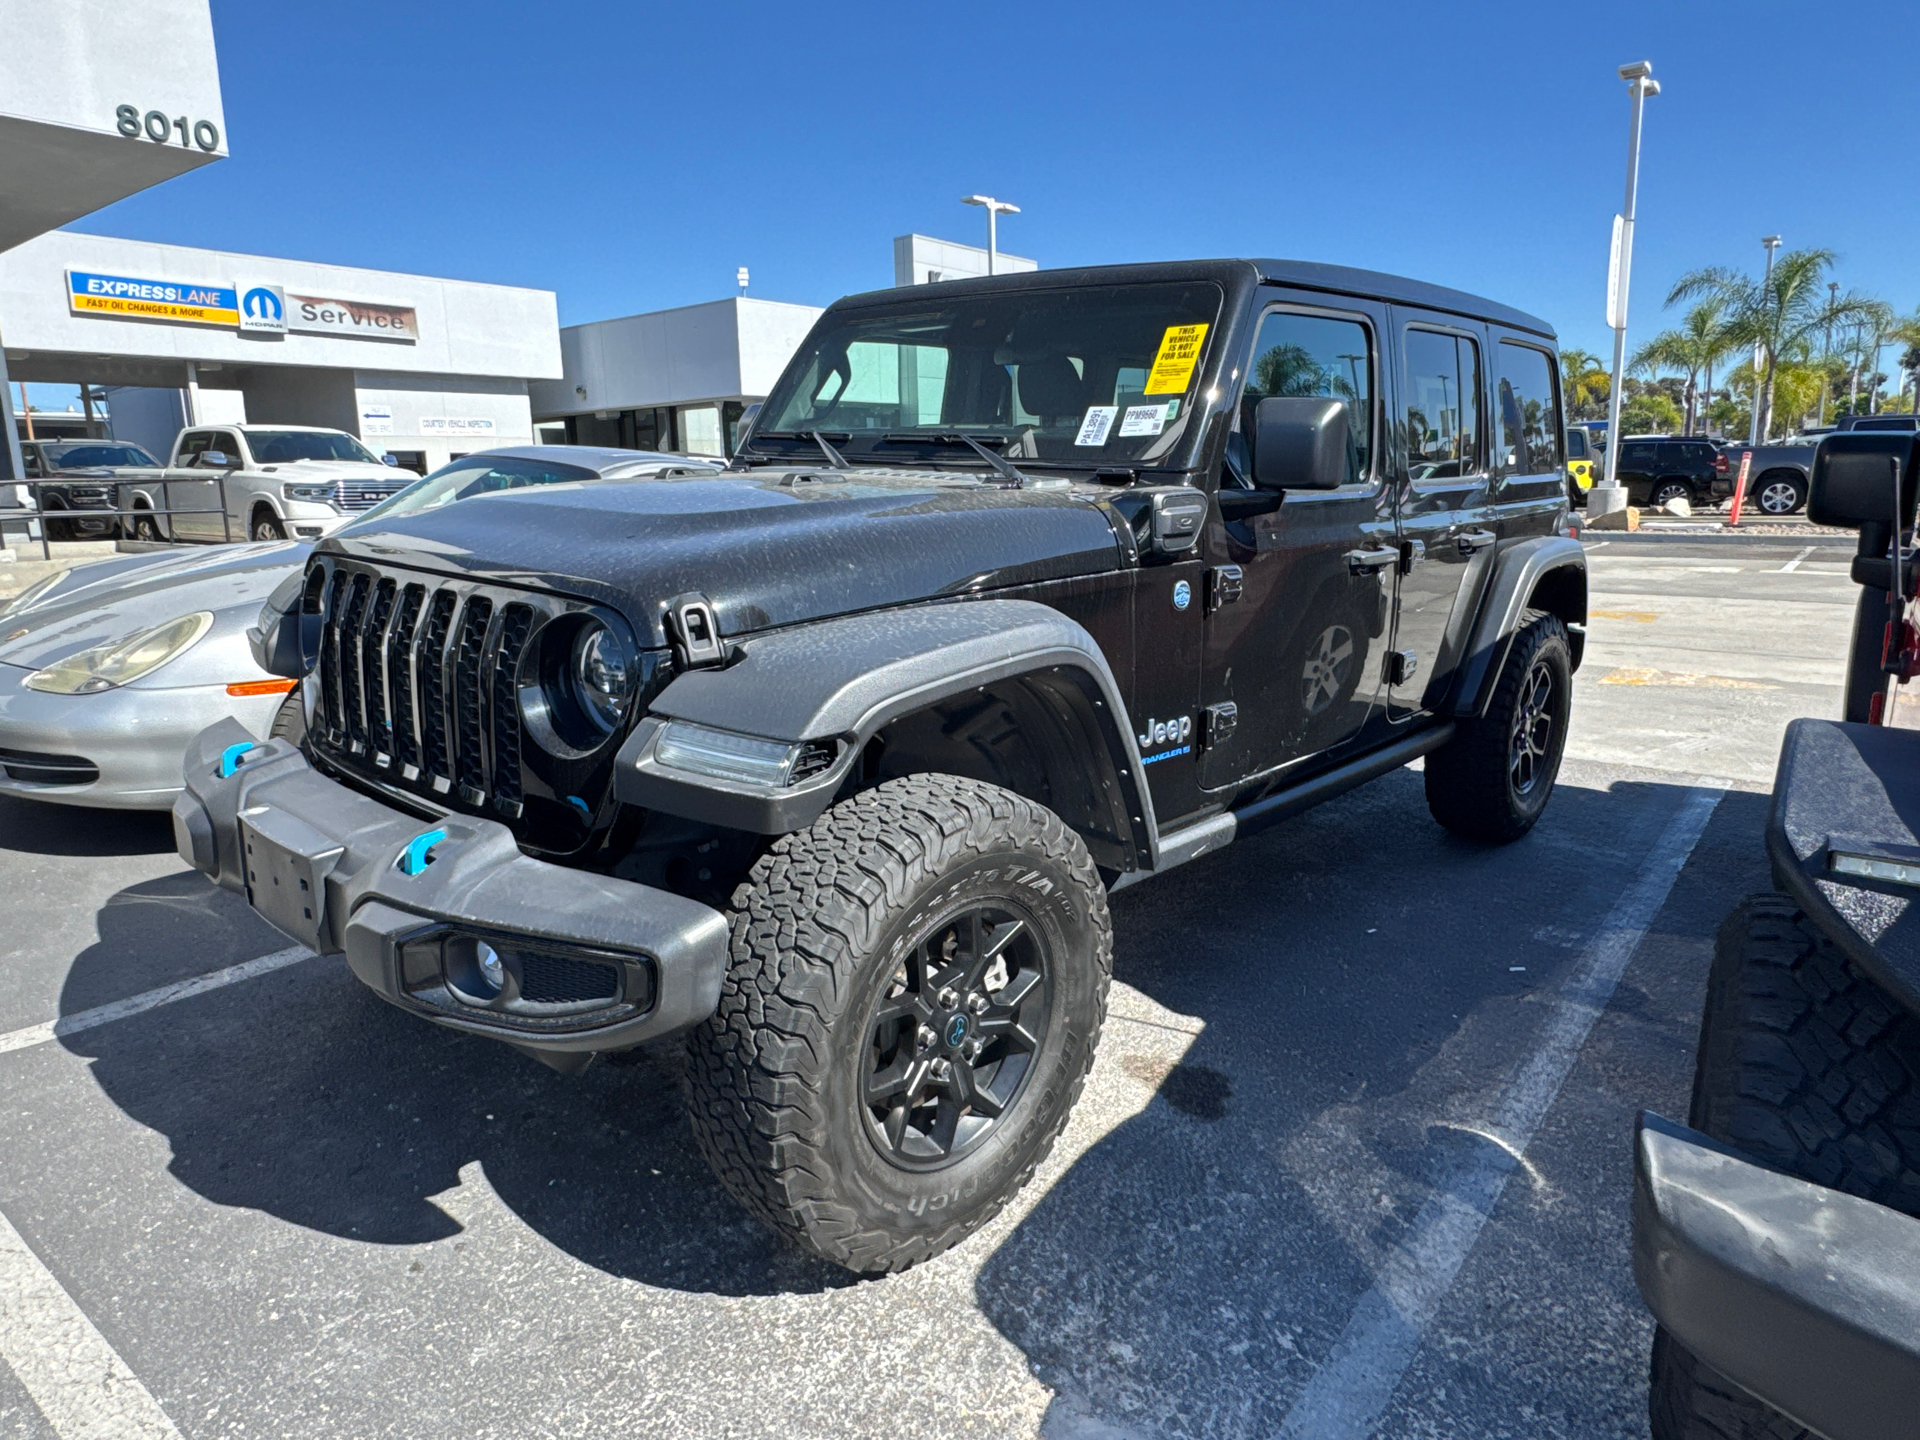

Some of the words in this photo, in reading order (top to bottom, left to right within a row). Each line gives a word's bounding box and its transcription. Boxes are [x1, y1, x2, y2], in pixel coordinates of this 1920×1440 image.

[116, 104, 219, 151] 8010
[87, 278, 221, 306] EXPRESSLANE
[86, 299, 108, 308] FAST
[111, 301, 124, 310] OIL
[127, 303, 169, 314] CHANGES
[170, 307, 177, 315] &
[179, 308, 204, 317] MORE
[301, 303, 405, 330] Service
[244, 321, 283, 329] MOPAR
[1178, 326, 1197, 335] THIS
[1168, 334, 1200, 344] VEHICLE
[1177, 343, 1194, 351] NOT
[1160, 352, 1176, 360] FOR
[1176, 350, 1196, 359] SALE
[1138, 715, 1192, 748] Jeep
